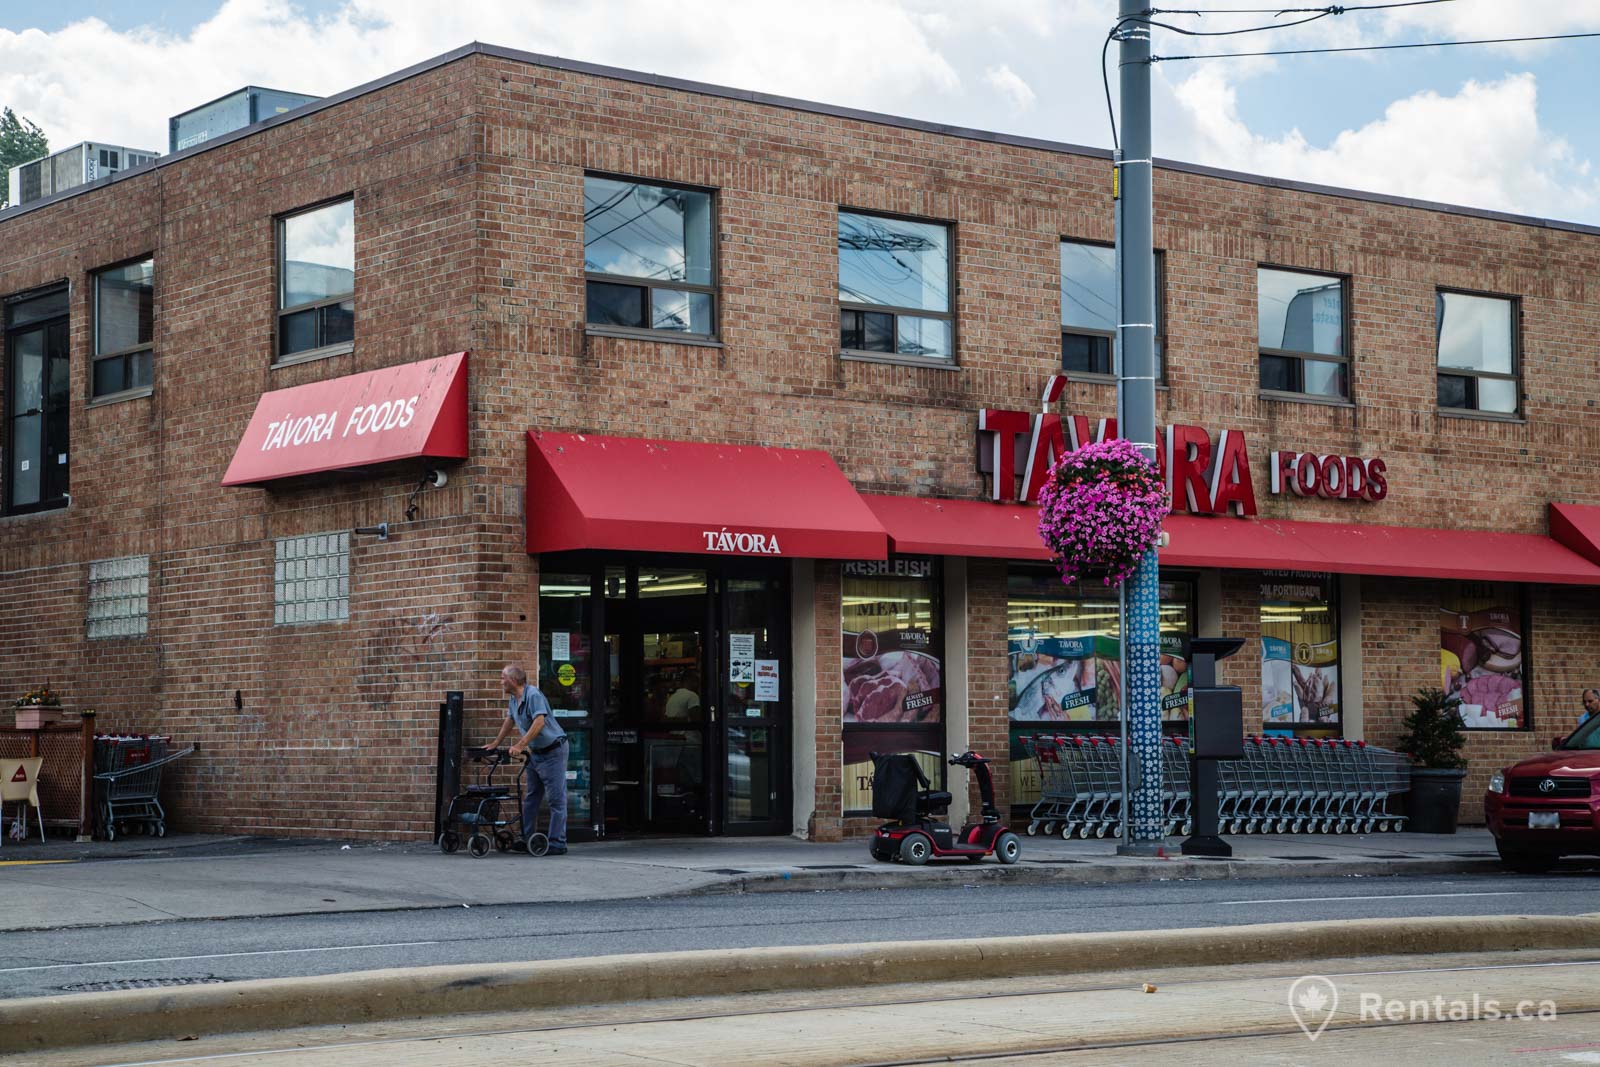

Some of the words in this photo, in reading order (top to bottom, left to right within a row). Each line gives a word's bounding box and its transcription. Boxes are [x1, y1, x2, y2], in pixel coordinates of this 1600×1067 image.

[261, 411, 338, 451] TÁVORA
[342, 396, 419, 438] FOODS
[1271, 451, 1388, 501] FOODS
[703, 527, 781, 554] TÁVORA
[844, 560, 889, 573] RESH
[895, 560, 931, 576] FISH
[906, 696, 933, 710] FRESH
[1065, 695, 1090, 709] FRESH
